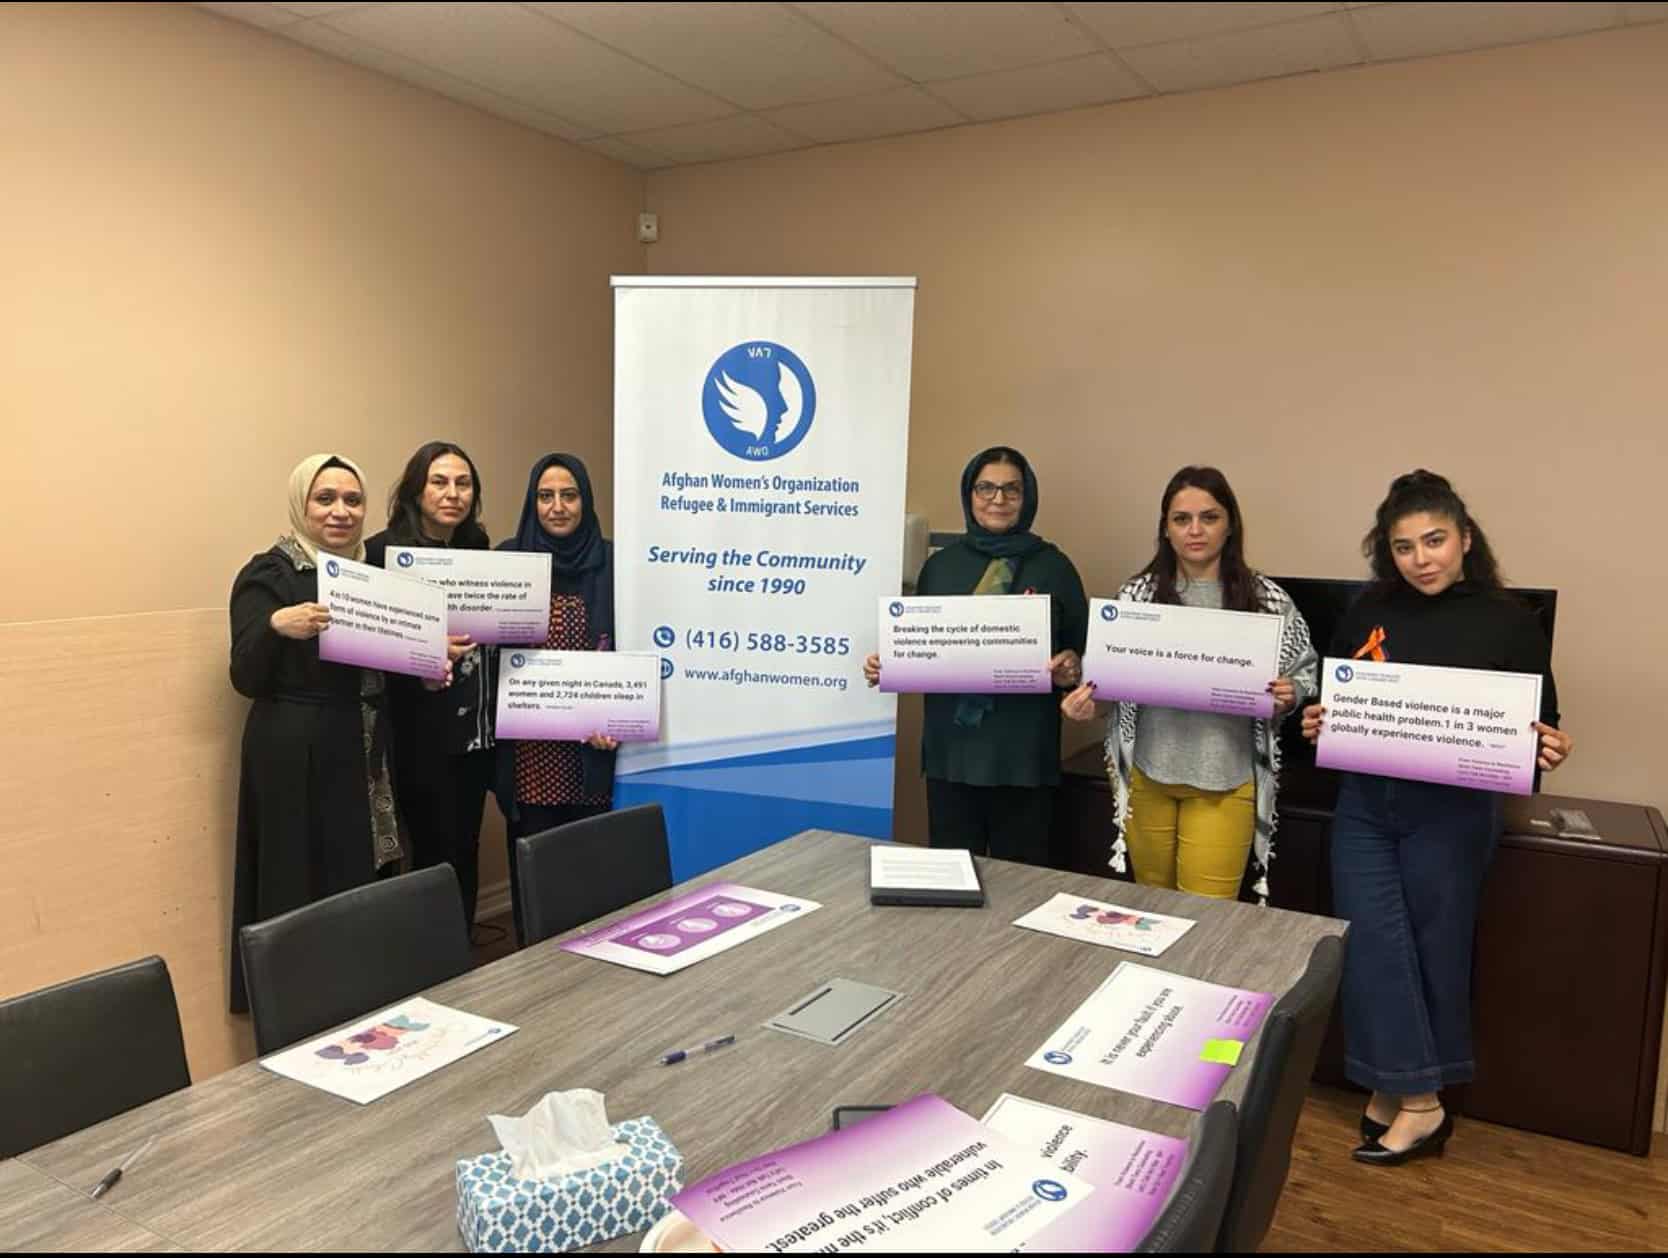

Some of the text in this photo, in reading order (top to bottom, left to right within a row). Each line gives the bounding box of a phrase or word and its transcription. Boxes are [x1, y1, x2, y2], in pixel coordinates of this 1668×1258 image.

[746, 446, 769, 457] AWO
[662, 472, 859, 494] Afghan Women's Organization
[661, 496, 858, 517] Refugee & Immigrant Services
[648, 546, 866, 574] Serving the Community
[440, 578, 456, 586] who
[458, 579, 488, 587] witness
[491, 580, 522, 588] violence
[708, 576, 805, 595] since 1990
[501, 592, 516, 600] rate
[519, 592, 527, 600] of
[330, 601, 345, 612] form
[355, 611, 380, 620] violence
[398, 620, 421, 630] intimate
[350, 596, 371, 605] women
[373, 601, 387, 610] have
[389, 606, 423, 618] experienced
[425, 614, 440, 622] some
[363, 624, 376, 632] their
[893, 624, 1020, 634] Breaking the cycle of domestic
[686, 628, 850, 655] (416) 588-3585
[929, 638, 980, 647] empowering
[982, 637, 1038, 645] communities
[1105, 644, 1126, 653] Your
[1129, 647, 1153, 657] voice
[1156, 650, 1164, 658] is
[1174, 650, 1198, 661] force
[1201, 653, 1215, 662] for
[1217, 655, 1254, 667] change.
[522, 679, 536, 687] any
[539, 679, 560, 690] given
[562, 679, 582, 689] night
[593, 681, 623, 689] Canada,
[684, 667, 847, 690] www.afghanwomen.org
[540, 690, 554, 698] and
[556, 691, 578, 699] 2,724
[580, 691, 611, 699] children
[614, 692, 634, 700] sleep
[1333, 694, 1368, 706] Gender
[1371, 697, 1401, 708] Based
[1405, 701, 1448, 713] violence
[1451, 706, 1461, 714] is
[1473, 709, 1505, 720] major
[1332, 708, 1362, 719] public
[1364, 711, 1396, 723] health
[1454, 720, 1464, 729] in
[1468, 722, 1473, 731] 3
[1477, 723, 1517, 736] women
[1331, 722, 1485, 748] globally experiences violence.
[1040, 1124, 1073, 1158] violence
[924, 1141, 987, 1177] vulnerable
[984, 1160, 1004, 1170] In
[898, 1174, 928, 1189] who
[951, 1168, 989, 1191] times
[859, 1186, 900, 1208] suffer
[936, 1187, 953, 1203] of
[834, 1203, 861, 1219] the
[882, 1195, 938, 1224] conflict,
[765, 1211, 835, 1253] greatest.
[837, 1230, 867, 1247] the
